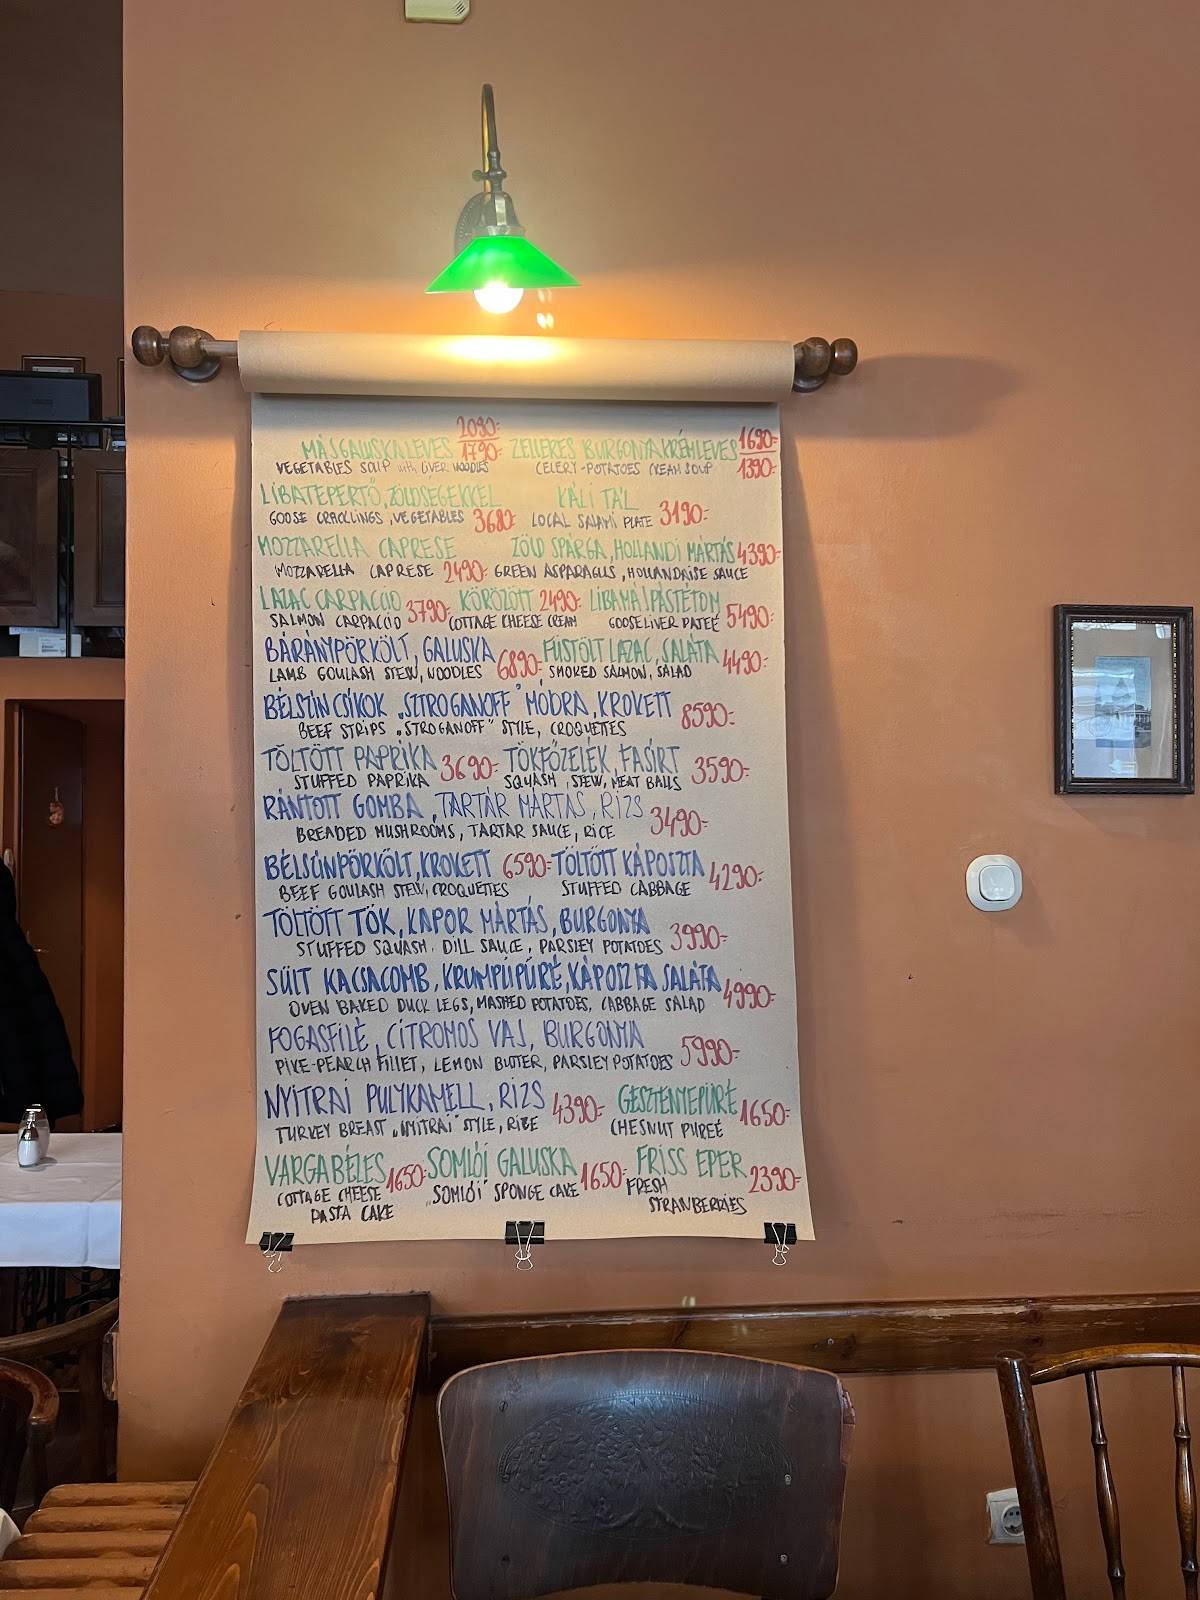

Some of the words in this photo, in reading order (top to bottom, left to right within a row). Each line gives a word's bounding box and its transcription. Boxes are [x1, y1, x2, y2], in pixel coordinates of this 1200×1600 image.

[276, 460, 353, 475] VEGETABLES
[360, 459, 391, 474] SOUP
[685, 463, 713, 476] SOUP
[600, 486, 640, 511] TÁL
[269, 510, 307, 525] GOOSE
[532, 511, 571, 528] LOCAL
[624, 515, 653, 529] PLATE
[257, 534, 369, 558] MOZZARELLA
[379, 536, 457, 559] CAPRESE
[275, 562, 355, 579] MOZZARELLA
[370, 563, 434, 579] CAPRESE
[494, 563, 537, 579] GREEN
[713, 567, 749, 580] SAUCE
[260, 585, 311, 610] LAZAC
[270, 612, 325, 628] SALMON
[448, 614, 498, 631] COTTAGE
[501, 614, 543, 629] CHEESE
[547, 614, 578, 628] CREAM
[422, 635, 497, 663] GALUSKA
[269, 666, 307, 683] LAMB
[317, 665, 376, 681] GOULASH
[427, 664, 483, 680] NOODLES
[549, 665, 597, 679] SMOKED
[657, 664, 692, 679] SALAD
[298, 721, 333, 739] BEEF
[340, 719, 386, 739] STRIPS
[353, 739, 438, 771] PAPRIKA
[294, 772, 358, 790] STUFFED
[367, 771, 430, 789] PAPRIKA
[612, 774, 640, 789] MEAT
[646, 774, 682, 791] BALLS
[296, 825, 367, 843] BREADED
[467, 822, 526, 839] TARTAR
[583, 823, 616, 839] RICE
[278, 883, 320, 903] BEEF
[328, 883, 385, 901] GOULASH
[562, 880, 622, 897] STUFFED
[630, 880, 692, 898] CABBAGE
[407, 906, 474, 935] KAPOR
[296, 940, 366, 958] STUFFED
[442, 935, 475, 955] DILL
[539, 938, 594, 955] PARSLEY
[602, 939, 664, 956] POTATOES
[288, 1000, 330, 1018] OVEN
[336, 997, 390, 1016] BAKED
[398, 997, 431, 1013] DUCK
[476, 994, 527, 1011] MASHED
[601, 995, 657, 1013] CABBAGE
[665, 996, 705, 1014] SALAD
[434, 1055, 483, 1073] LEMON
[552, 1054, 609, 1071] PARSLEY
[264, 1078, 352, 1119] NYITRAI
[498, 1076, 546, 1110] RIZS
[275, 1122, 331, 1144] TURKEY
[338, 1118, 387, 1138] BREAST
[497, 1146, 578, 1178] GALUSKA
[636, 1144, 688, 1176] FRISS
[695, 1148, 747, 1179] EPER
[277, 1187, 332, 1207] COTTAGE
[338, 1185, 382, 1203] CHEESE
[494, 1181, 545, 1202] SPONGE
[549, 1181, 580, 1198] CAKE
[626, 1176, 668, 1196] FRESH
[310, 1204, 352, 1224] PASTA
[360, 1204, 394, 1222] CAKE
